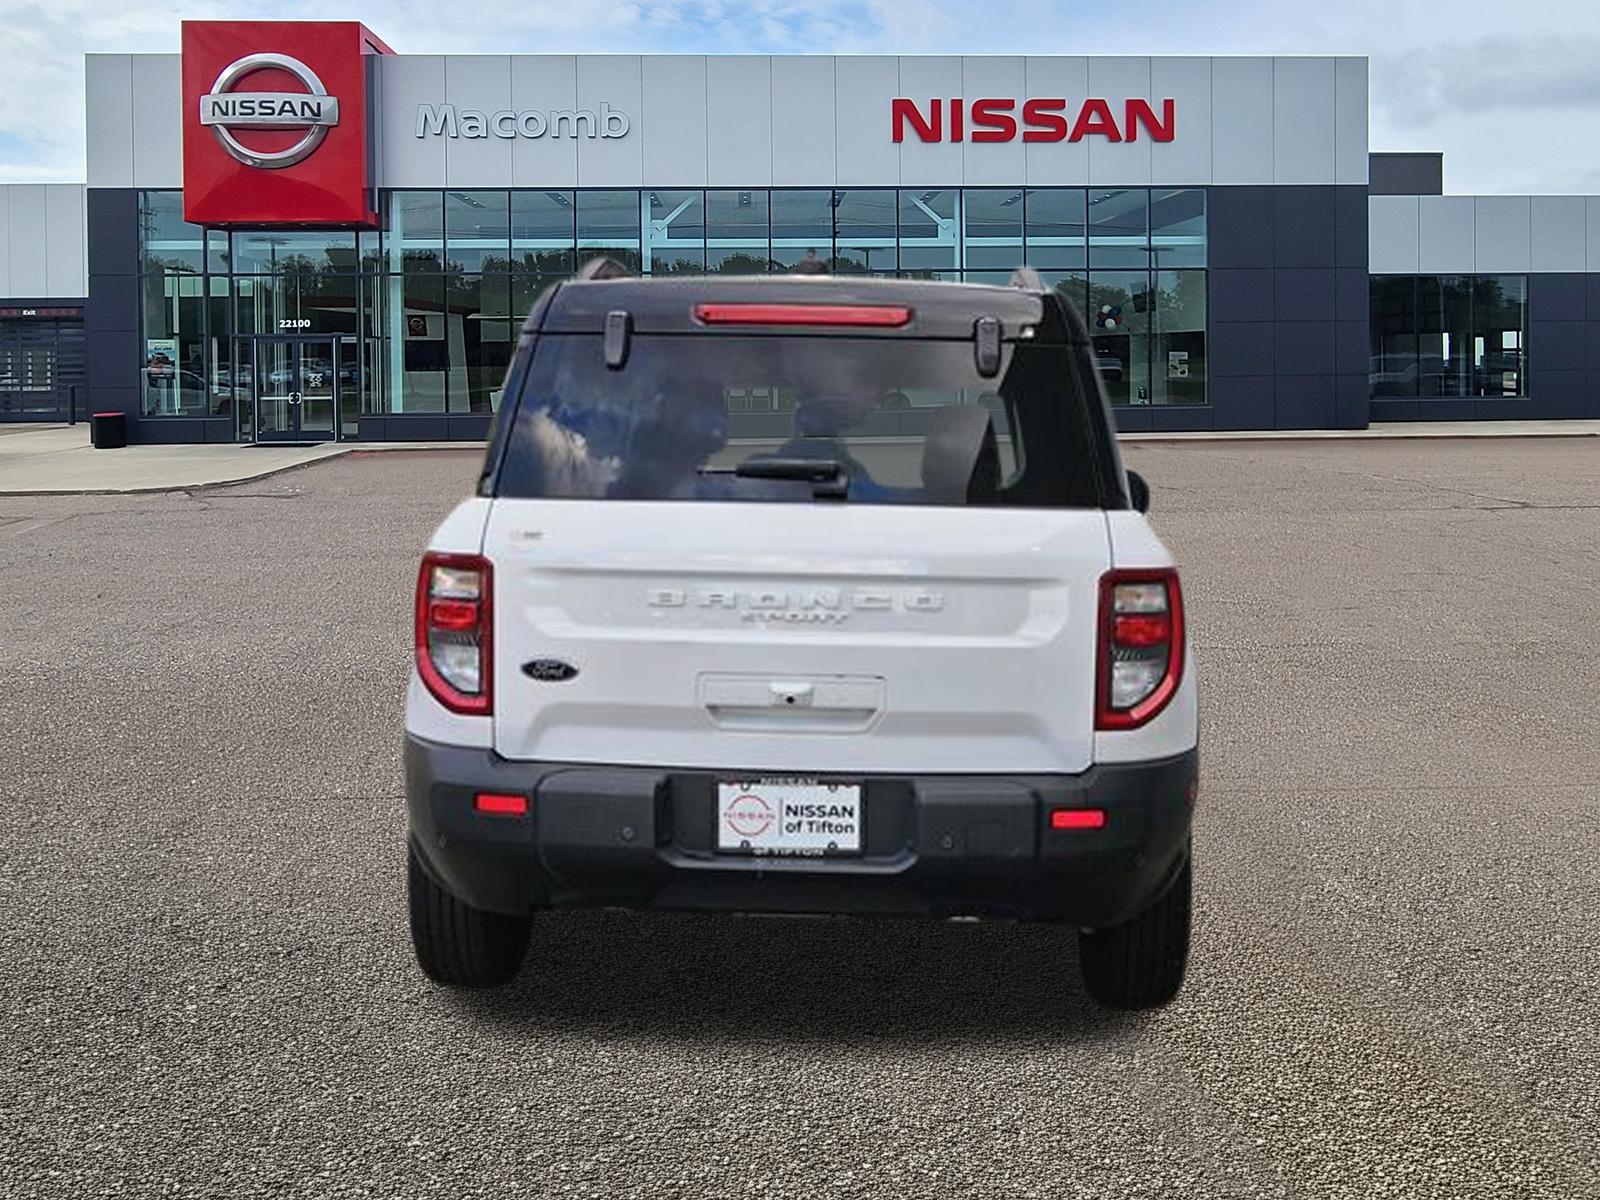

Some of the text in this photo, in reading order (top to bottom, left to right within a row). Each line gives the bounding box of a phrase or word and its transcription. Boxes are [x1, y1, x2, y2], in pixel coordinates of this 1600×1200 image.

[212, 100, 322, 118] NISSAN
[415, 102, 630, 139] Macomb
[892, 98, 1176, 143] NISSAN
[279, 319, 311, 328] 22100
[648, 588, 945, 612] BRONCO
[785, 804, 855, 817] NISSAN
[785, 820, 855, 833] of Tifton
